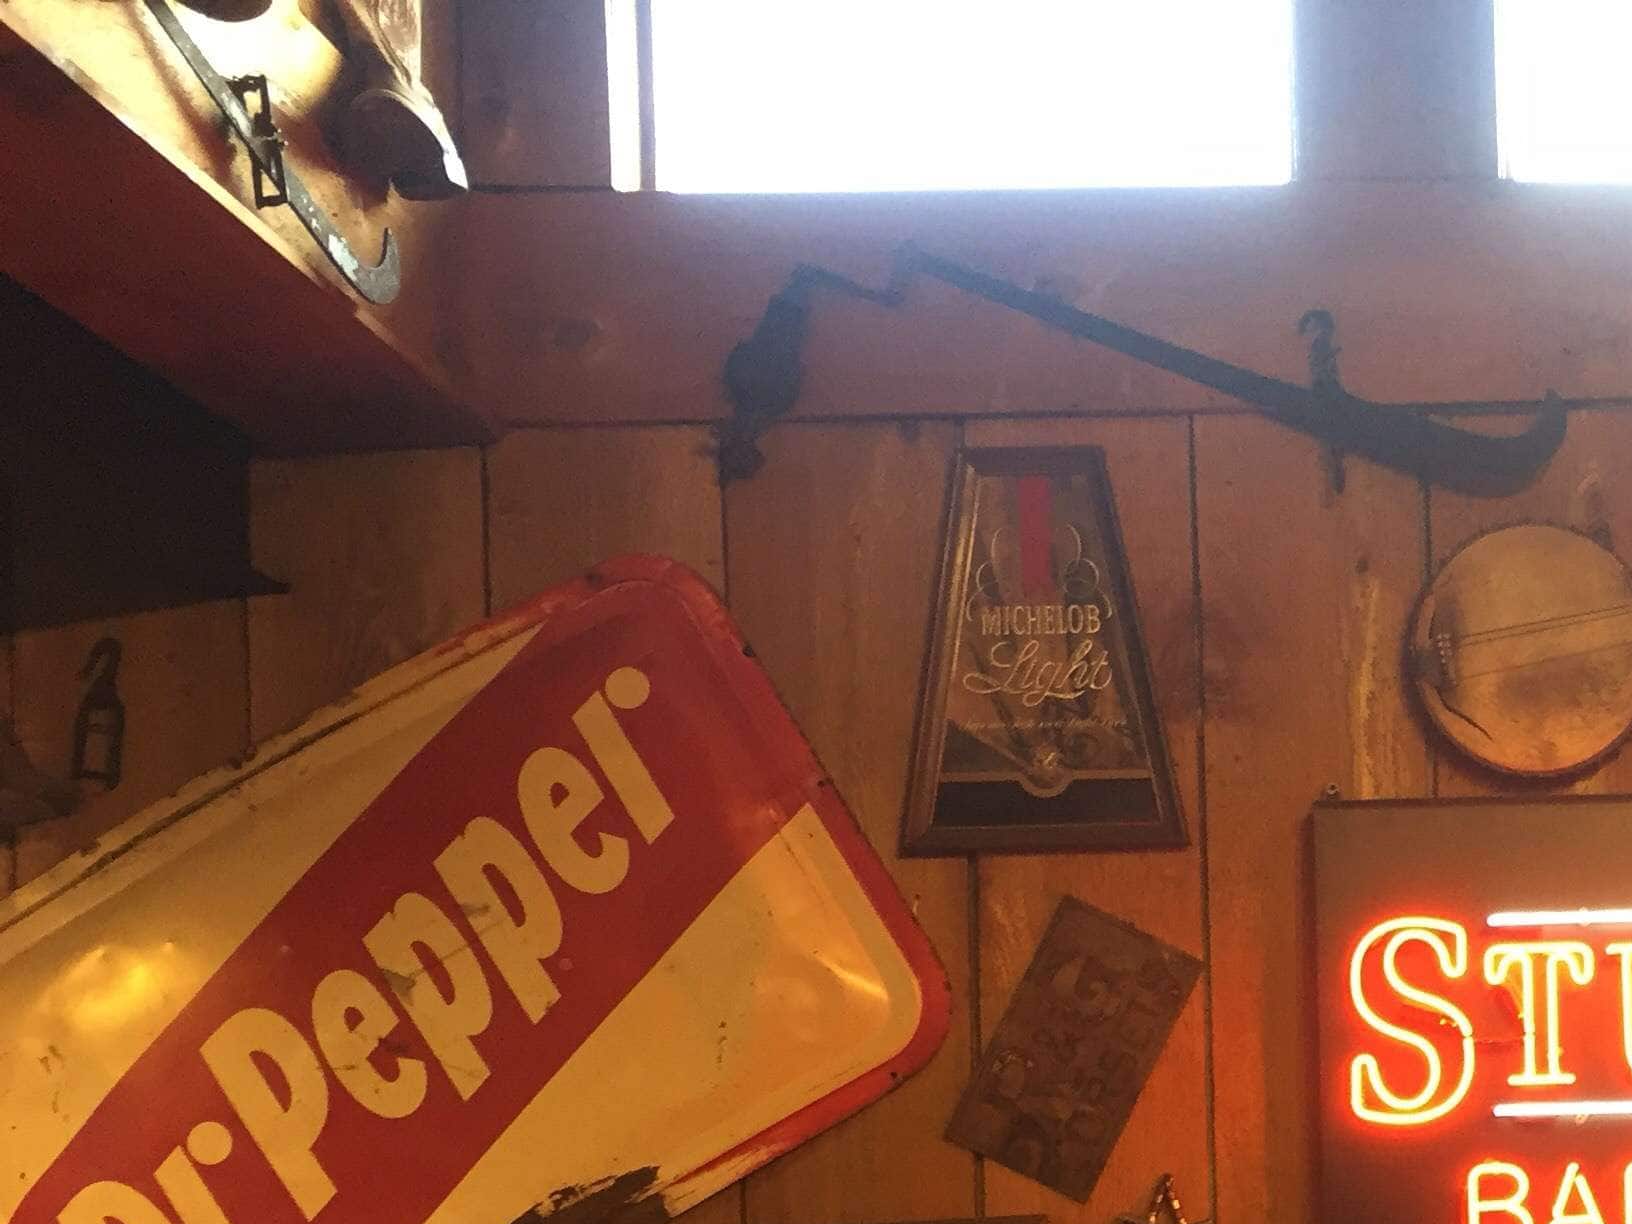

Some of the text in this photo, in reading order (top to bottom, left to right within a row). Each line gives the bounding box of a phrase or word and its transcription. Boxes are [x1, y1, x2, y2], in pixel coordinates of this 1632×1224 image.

[980, 603, 1103, 636] MICHELOB
[962, 640, 1113, 708] Light
[200, 666, 676, 1221] Pepper
